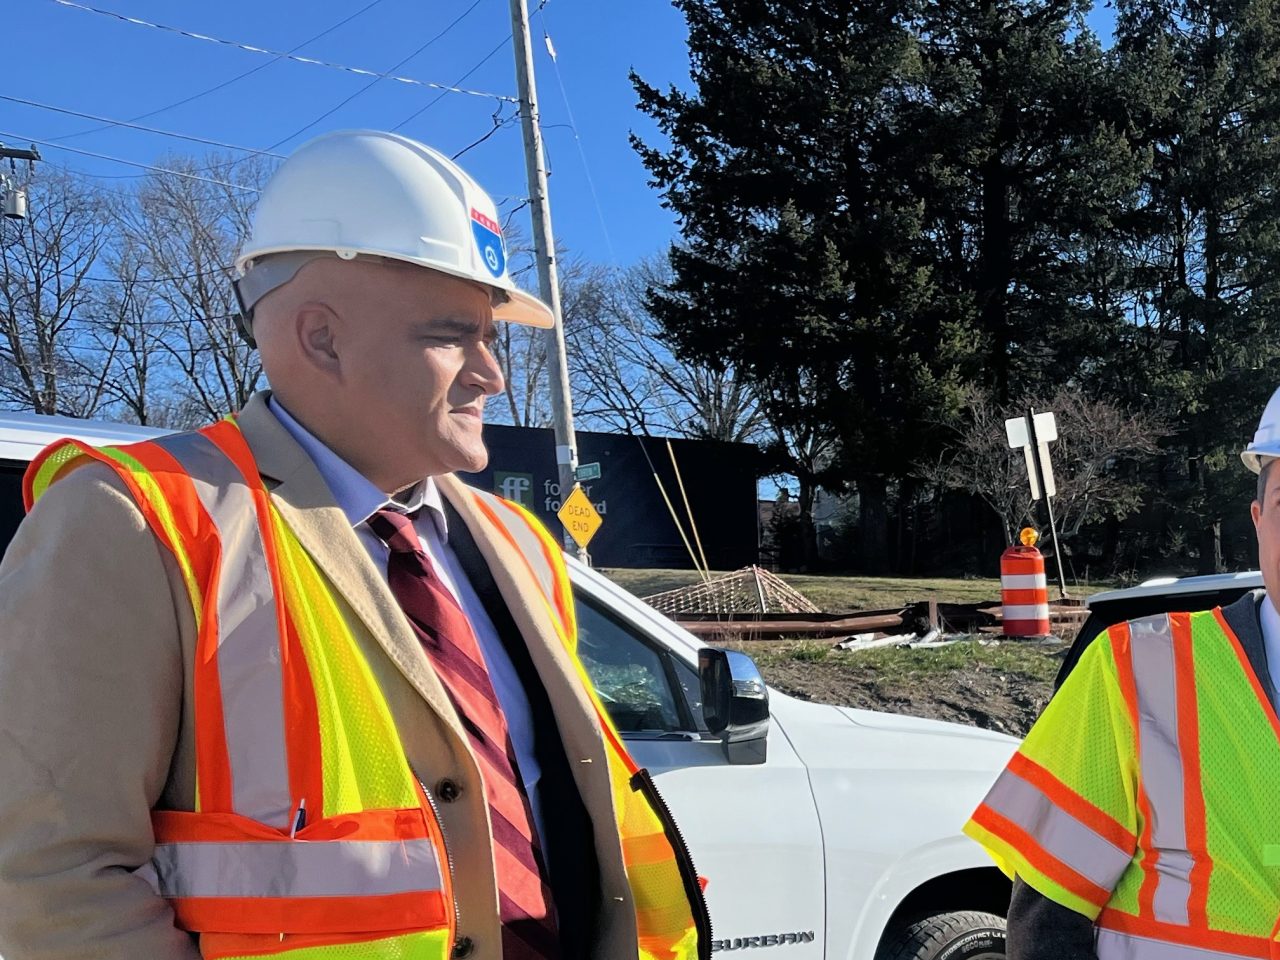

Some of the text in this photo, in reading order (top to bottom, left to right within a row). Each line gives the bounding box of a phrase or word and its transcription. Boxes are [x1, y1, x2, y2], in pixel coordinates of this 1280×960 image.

[544, 479, 593, 497] for
[568, 505, 591, 518] DEAD
[572, 521, 589, 533] END
[711, 930, 815, 952] BURBAN
